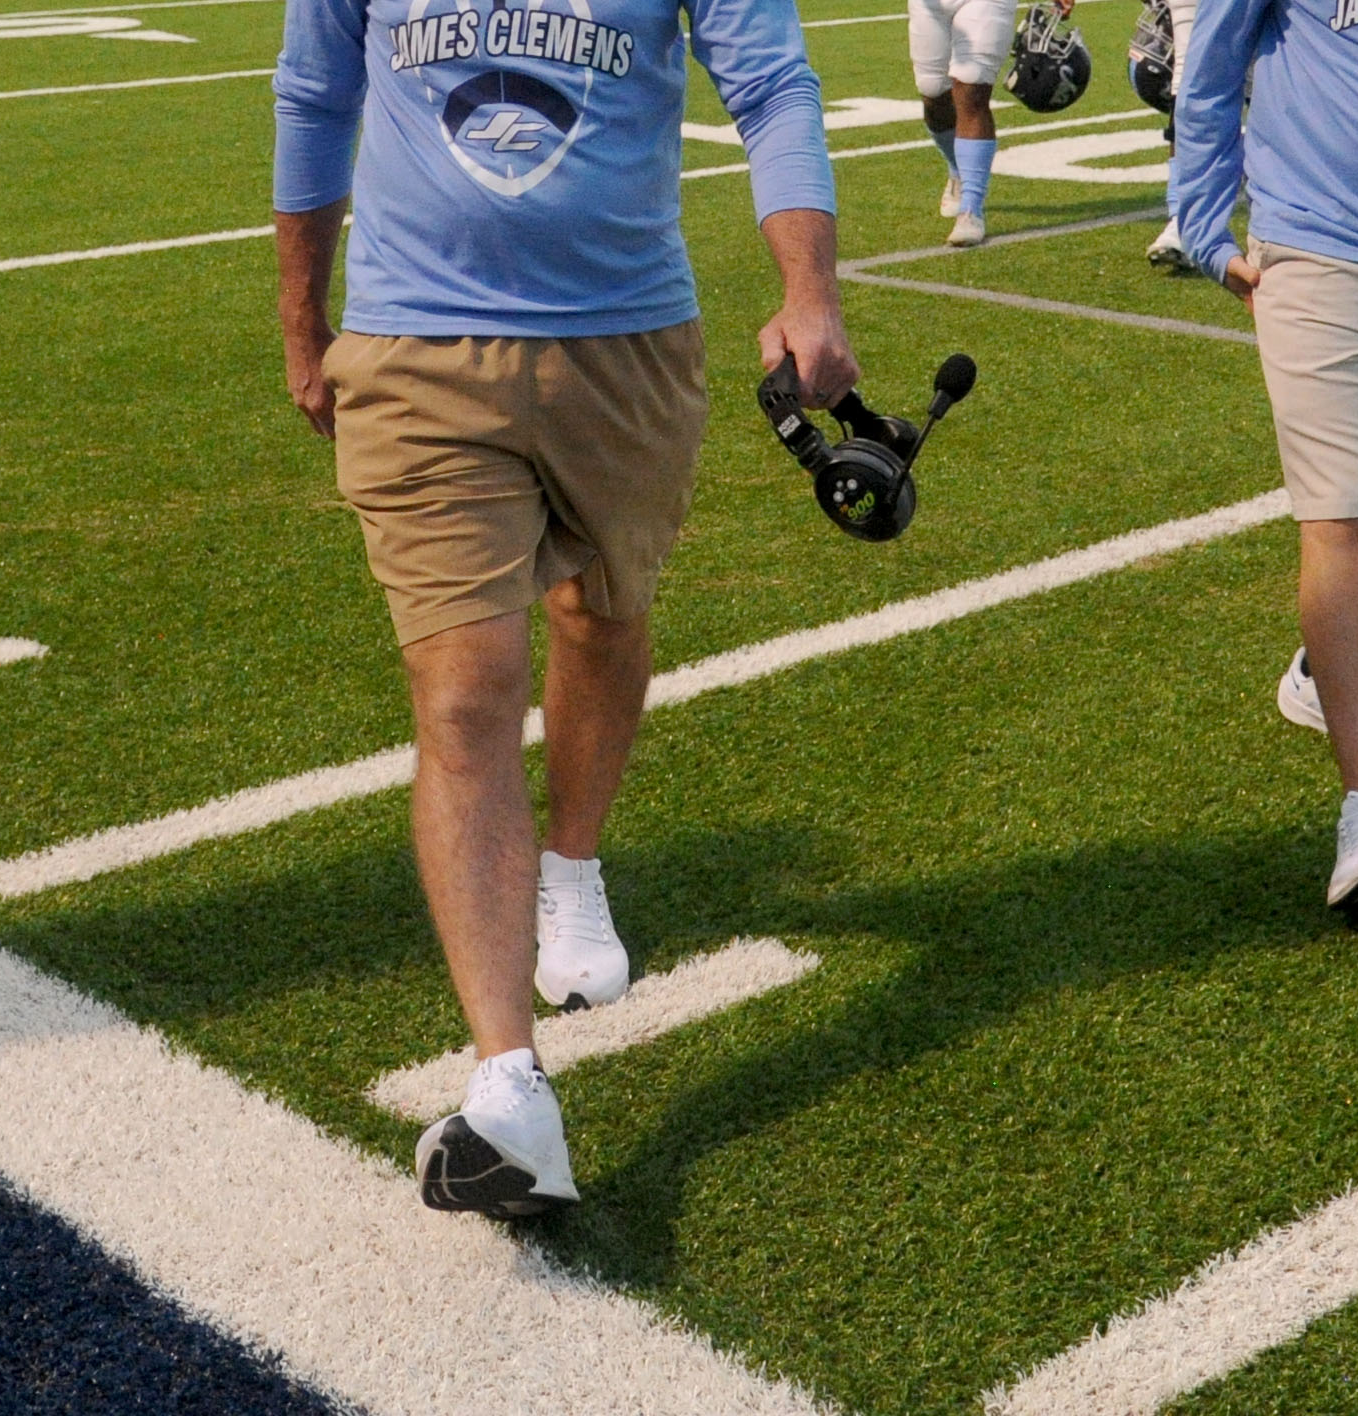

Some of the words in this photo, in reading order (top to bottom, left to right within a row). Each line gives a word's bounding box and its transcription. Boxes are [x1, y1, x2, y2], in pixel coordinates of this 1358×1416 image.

[390, 8, 480, 73] JAMES
[485, 8, 634, 79] CLEMENS
[847, 492, 876, 521] 900
